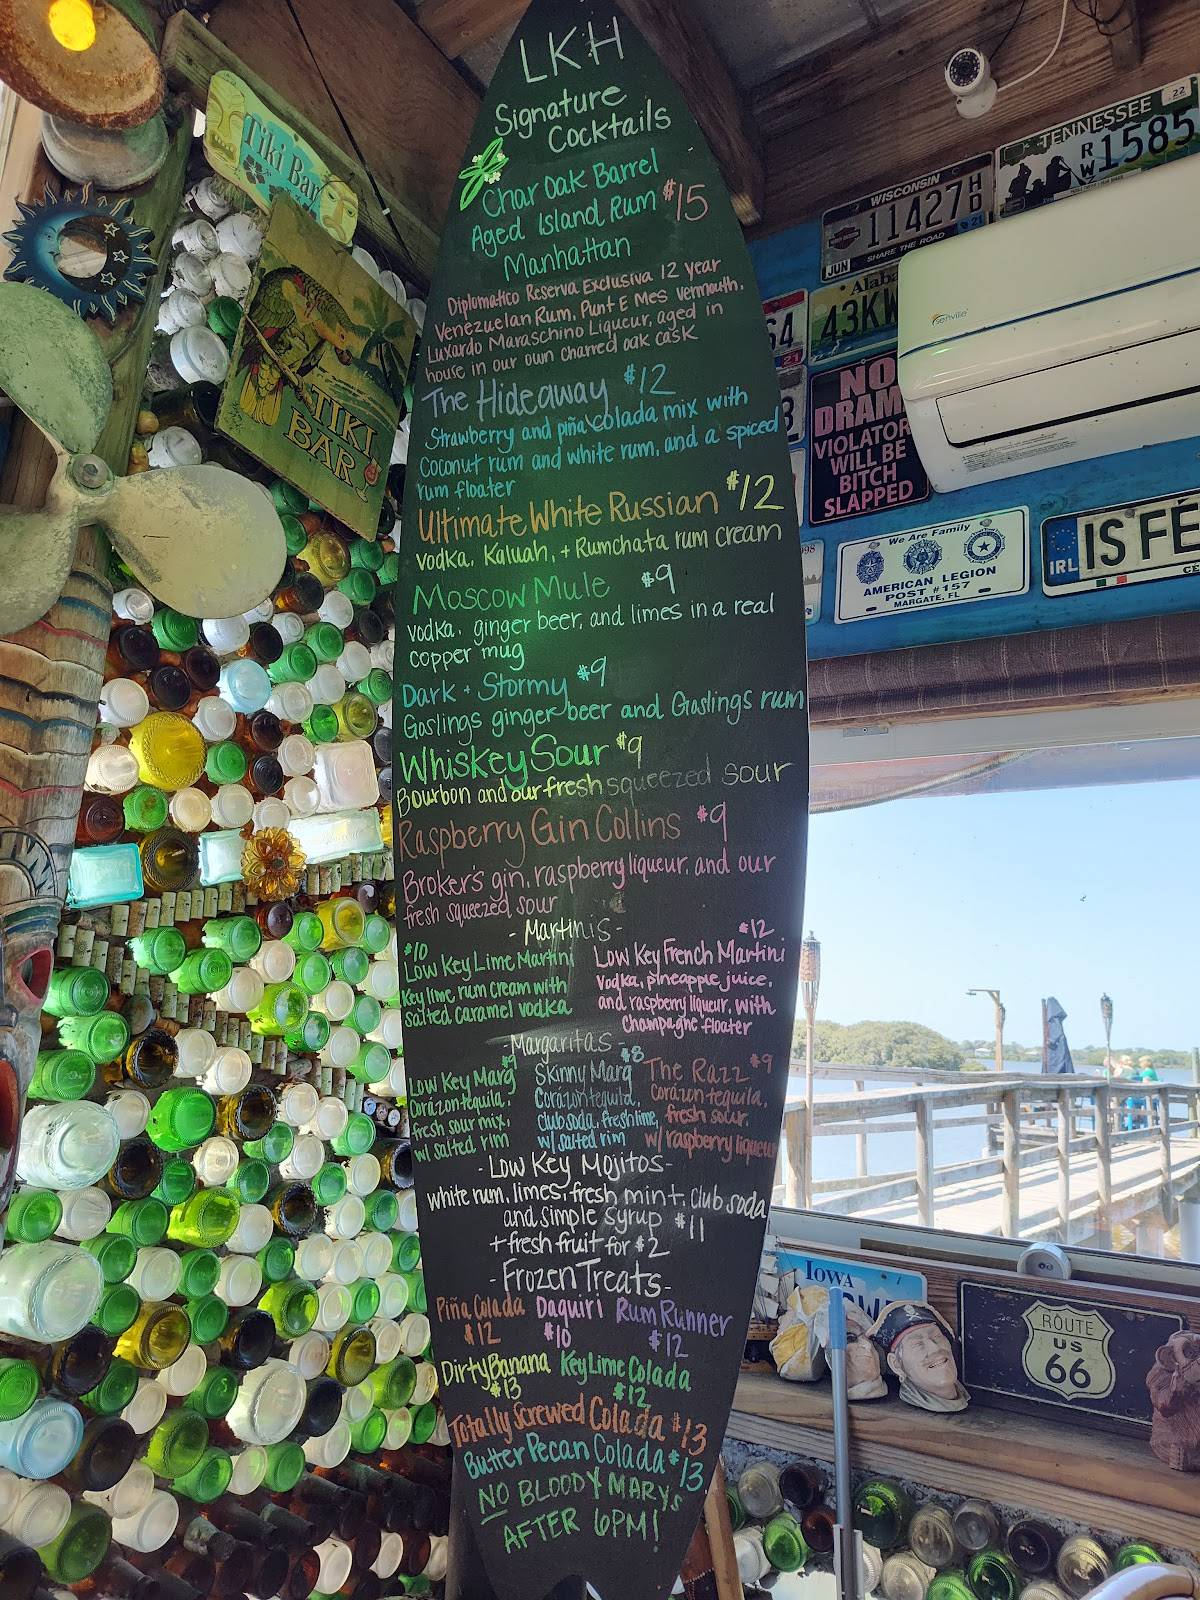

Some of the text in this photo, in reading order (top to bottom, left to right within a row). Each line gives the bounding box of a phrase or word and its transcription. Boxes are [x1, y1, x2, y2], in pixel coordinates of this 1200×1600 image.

[519, 16, 624, 83] LKH
[494, 84, 627, 140] Signature
[1172, 86, 1187, 98] 22
[549, 99, 671, 153] Cocktails
[1041, 97, 1152, 148] TENNESSEE
[1099, 105, 1195, 173] 1585
[243, 115, 321, 202] Tiki Bar
[482, 148, 660, 218] Char Oak Barrel
[870, 174, 941, 207] WISCONSIN
[471, 178, 709, 258] Aged Island Rum $15
[867, 180, 963, 248] 11427
[971, 215, 984, 229] 21
[503, 234, 632, 282] Manhattan
[866, 231, 946, 263] SHARE THE ROAD
[447, 257, 722, 322] Diplomatico Reserva Exclusiva 12 year
[827, 260, 849, 278] JUN
[851, 270, 898, 296] Alaba
[425, 324, 699, 384] house in our own charred oak cask
[783, 352, 800, 367] 21
[421, 363, 677, 424] The Hideaway $12
[840, 357, 896, 401] NO
[311, 383, 378, 460] TIKI
[425, 422, 515, 454] Strawberry
[522, 416, 552, 441] and
[557, 414, 588, 438] piña
[663, 398, 699, 421] mix
[706, 385, 749, 411] with
[814, 385, 907, 438] DRAM
[283, 404, 355, 488] BAR
[813, 417, 912, 459] VIOLATOR
[830, 438, 907, 476] WILL BE
[824, 479, 914, 518] SLAPPED
[839, 462, 897, 495] BITCH
[417, 470, 785, 545] Ultimate White Russian $12
[888, 523, 971, 546] We Are Family
[1085, 518, 1126, 570] IS
[863, 566, 997, 597] AMERICAN LEGION
[1049, 558, 1078, 576] IRL
[413, 563, 676, 615] Moscow Mule $9
[886, 580, 972, 602] POST #157
[893, 592, 960, 608] MARGATE, FL
[409, 641, 525, 671] copper mug
[402, 678, 457, 708] Dark
[477, 671, 568, 711] Stormy
[577, 656, 607, 687] $9
[399, 730, 643, 791] Whiskey Sour $9
[398, 801, 729, 869] Raspberry Gin Collins $9
[403, 892, 559, 930] fresh squeezed sour
[404, 946, 576, 983] Low Key Lime Martini
[593, 937, 787, 977] Low Key French Martini
[409, 1066, 517, 1097] Low Key Marg
[534, 1060, 633, 1088] Skinny Marg
[643, 1057, 684, 1081] The
[692, 1057, 750, 1084] Razz
[489, 1154, 526, 1179] Low
[532, 1151, 572, 1189] Key
[503, 1203, 705, 1243] and simple syrup $11
[502, 1258, 576, 1293] Frozen
[436, 1293, 734, 1337] Piña Colada Daquiri Rum Runner
[1041, 1312, 1095, 1336] ROUTE
[464, 1321, 689, 1358] $12 $10 $12
[1053, 1337, 1082, 1353] US
[440, 1350, 692, 1392] Dirty Banana Key Lime Colada
[1045, 1353, 1091, 1389] 66
[490, 1376, 651, 1409] $13 $12
[449, 1392, 708, 1457] Totally Screwed Colada $13
[463, 1432, 705, 1492] Butter Pecan Colada $13
[478, 1482, 510, 1517] NO
[518, 1466, 602, 1507] BLOODY
[503, 1507, 660, 1554] AFTER 6PM!
